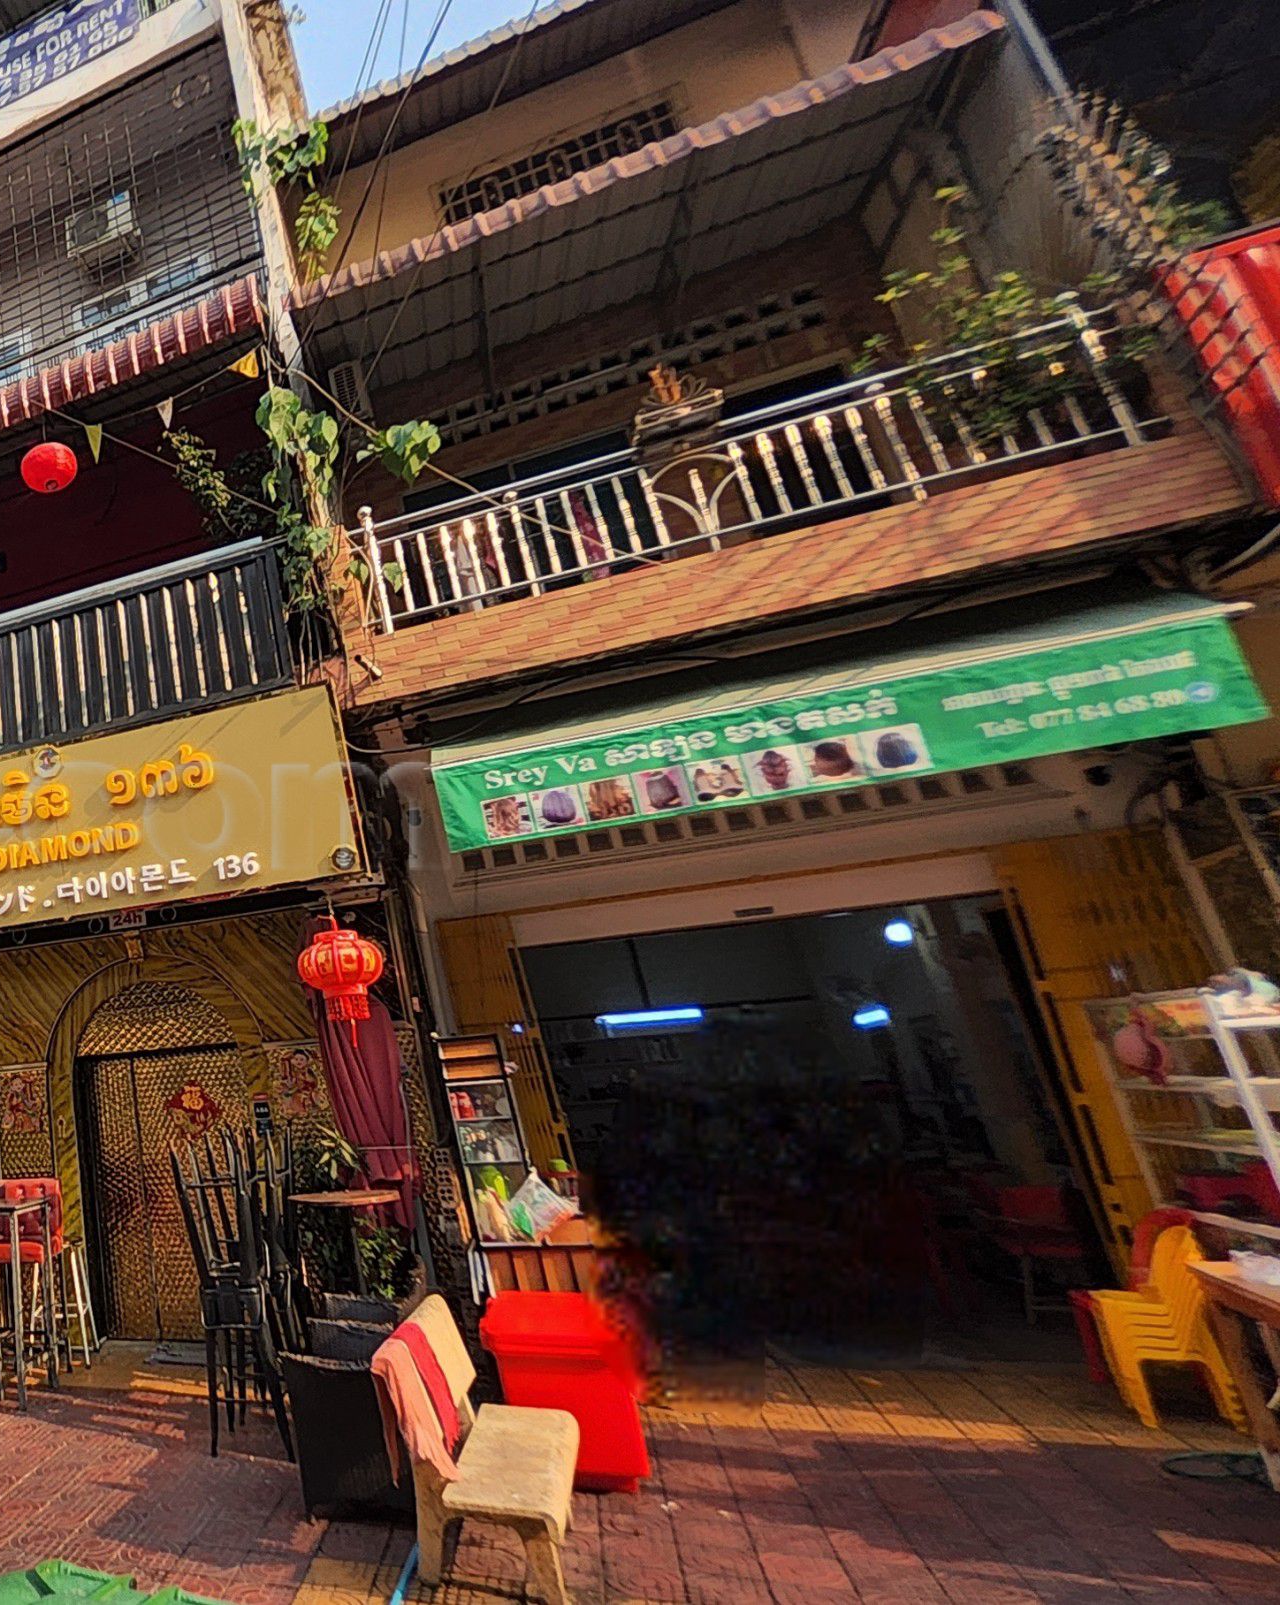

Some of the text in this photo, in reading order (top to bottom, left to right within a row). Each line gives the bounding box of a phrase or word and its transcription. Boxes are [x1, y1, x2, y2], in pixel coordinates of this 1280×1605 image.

[36, 29, 72, 62] FOR
[77, 1, 123, 37] RENT
[105, 743, 215, 806] ១៣៦
[484, 764, 548, 791] Srey
[556, 754, 597, 776] Va
[213, 852, 261, 881] 136
[112, 911, 142, 927] 24h
